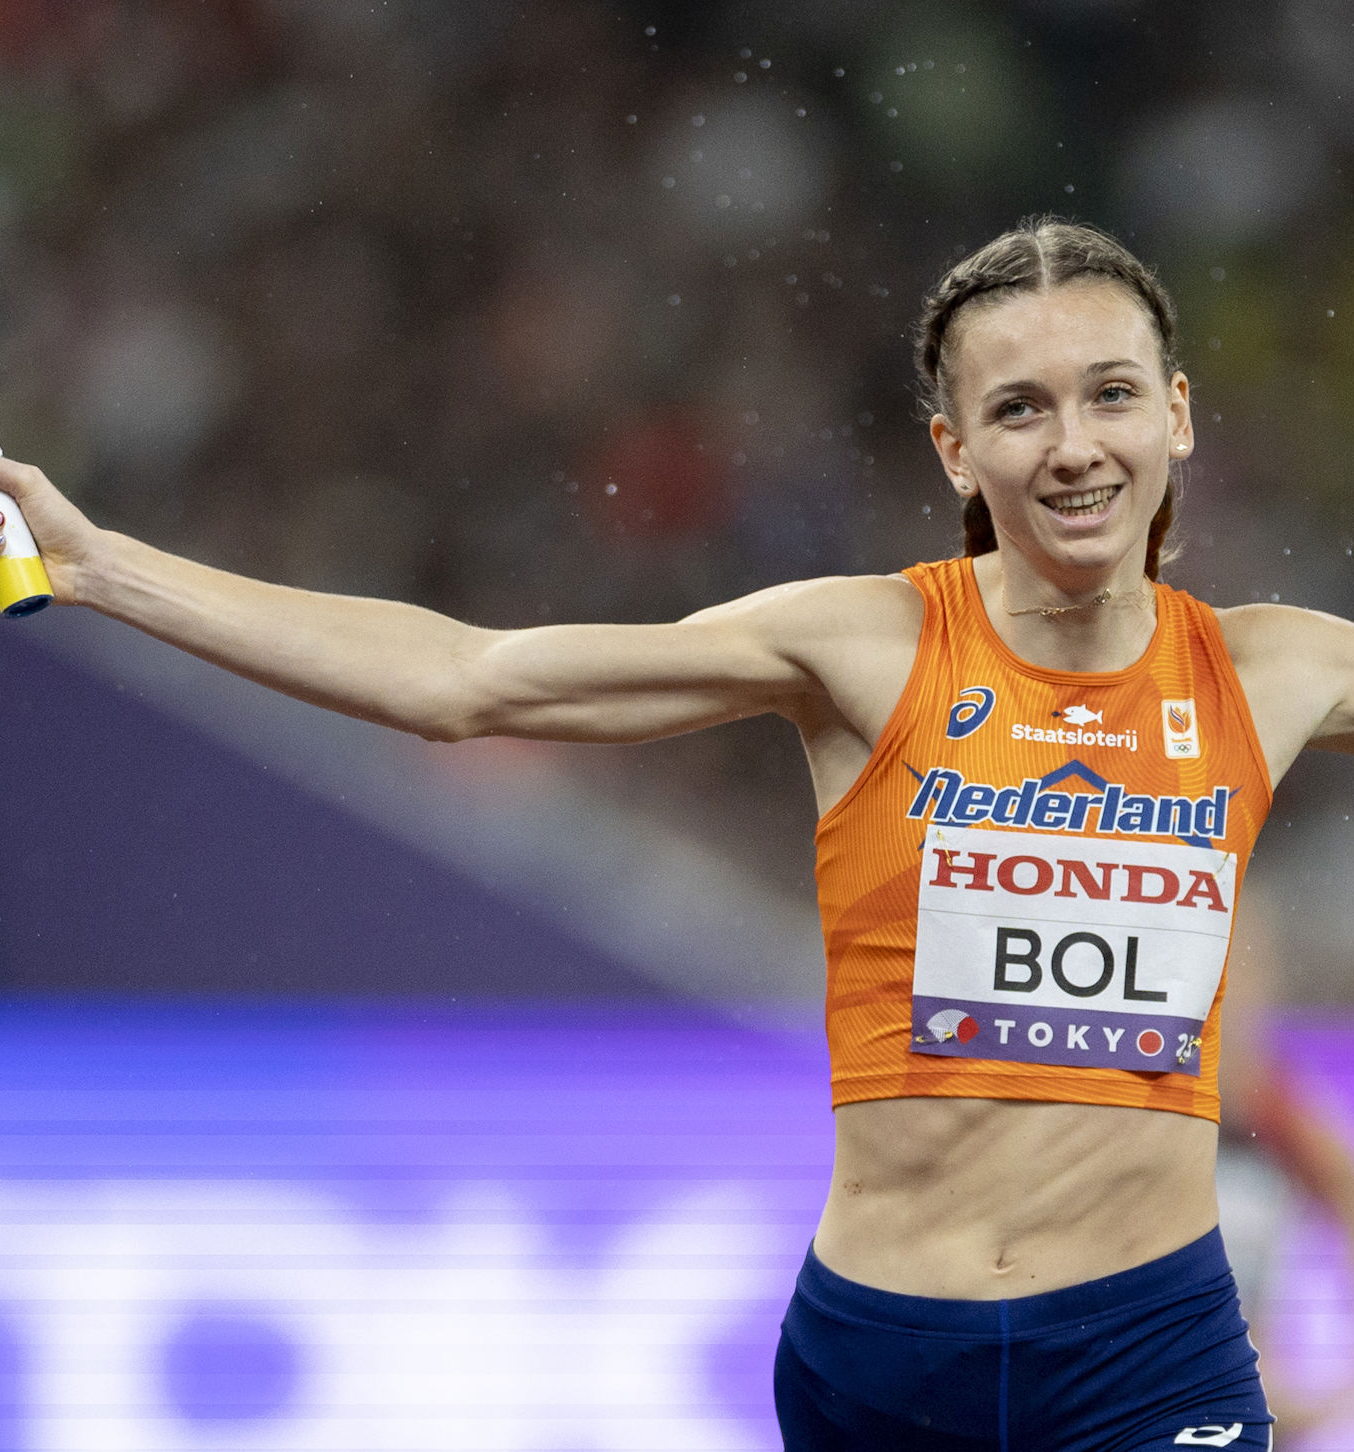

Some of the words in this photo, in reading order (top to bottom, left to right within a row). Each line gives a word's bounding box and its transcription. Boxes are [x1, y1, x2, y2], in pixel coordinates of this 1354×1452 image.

[1011, 724, 1138, 752] Staatsloterij
[929, 849, 1229, 914] HONDA
[994, 927, 1168, 1002] BOL
